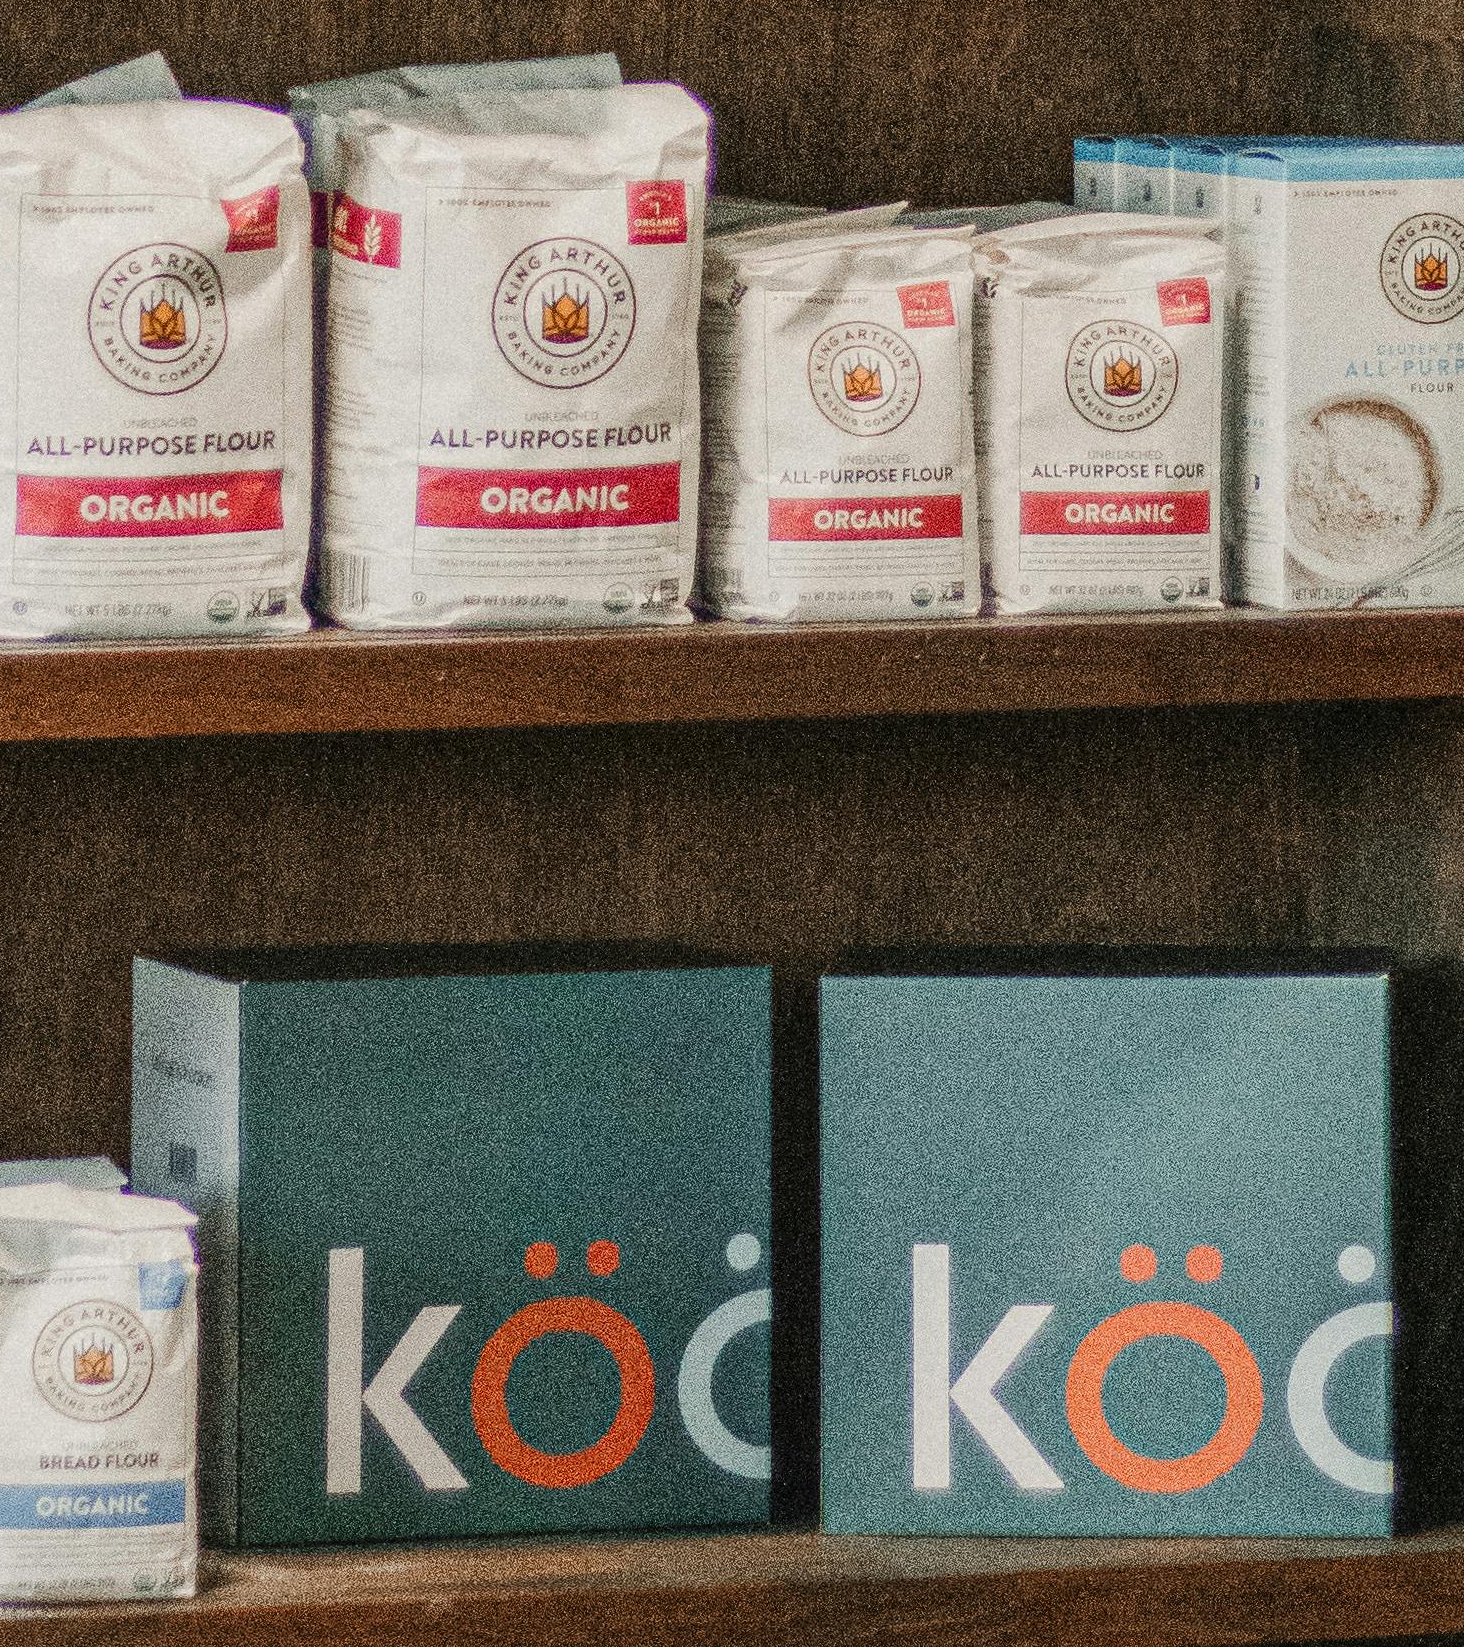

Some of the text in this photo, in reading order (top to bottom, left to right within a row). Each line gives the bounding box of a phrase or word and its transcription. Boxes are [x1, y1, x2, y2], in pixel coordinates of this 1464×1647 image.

[1387, 226, 1416, 263] KING
[99, 252, 217, 310] KING ARTHUR
[502, 245, 627, 306] KING ARTHUR
[1389, 280, 1424, 315] BAKING
[103, 334, 217, 384] BAKING COMPANY
[506, 328, 621, 378] BAKING COMPANY
[813, 328, 913, 373] KING ARTHUR
[1073, 326, 1172, 369] KING ARTHUR
[1376, 344, 1437, 356] GLUTEN
[1077, 385, 1168, 423] BAKING COMPANY
[1410, 383, 1455, 394] FLOUR
[819, 388, 912, 427] BAKING COMPANY
[27, 429, 277, 457] ALL-PURPOSE FLOUR
[430, 422, 673, 451] ALL-PURPOSE FLOUR
[779, 465, 954, 485] ALL-PURPOSE FLOUR
[1032, 462, 1206, 481] ALL-PURPOSE FLOUR
[79, 490, 230, 523] ORGANIC
[480, 484, 630, 515] ORGANIC
[1065, 503, 1175, 525] ORGANIC
[814, 507, 924, 531] ORGANIC
[41, 1308, 147, 1357] KING ARTHUR
[39, 1454, 160, 1471] BREAD FLOUR
[37, 1494, 149, 1516] ORGANIC
